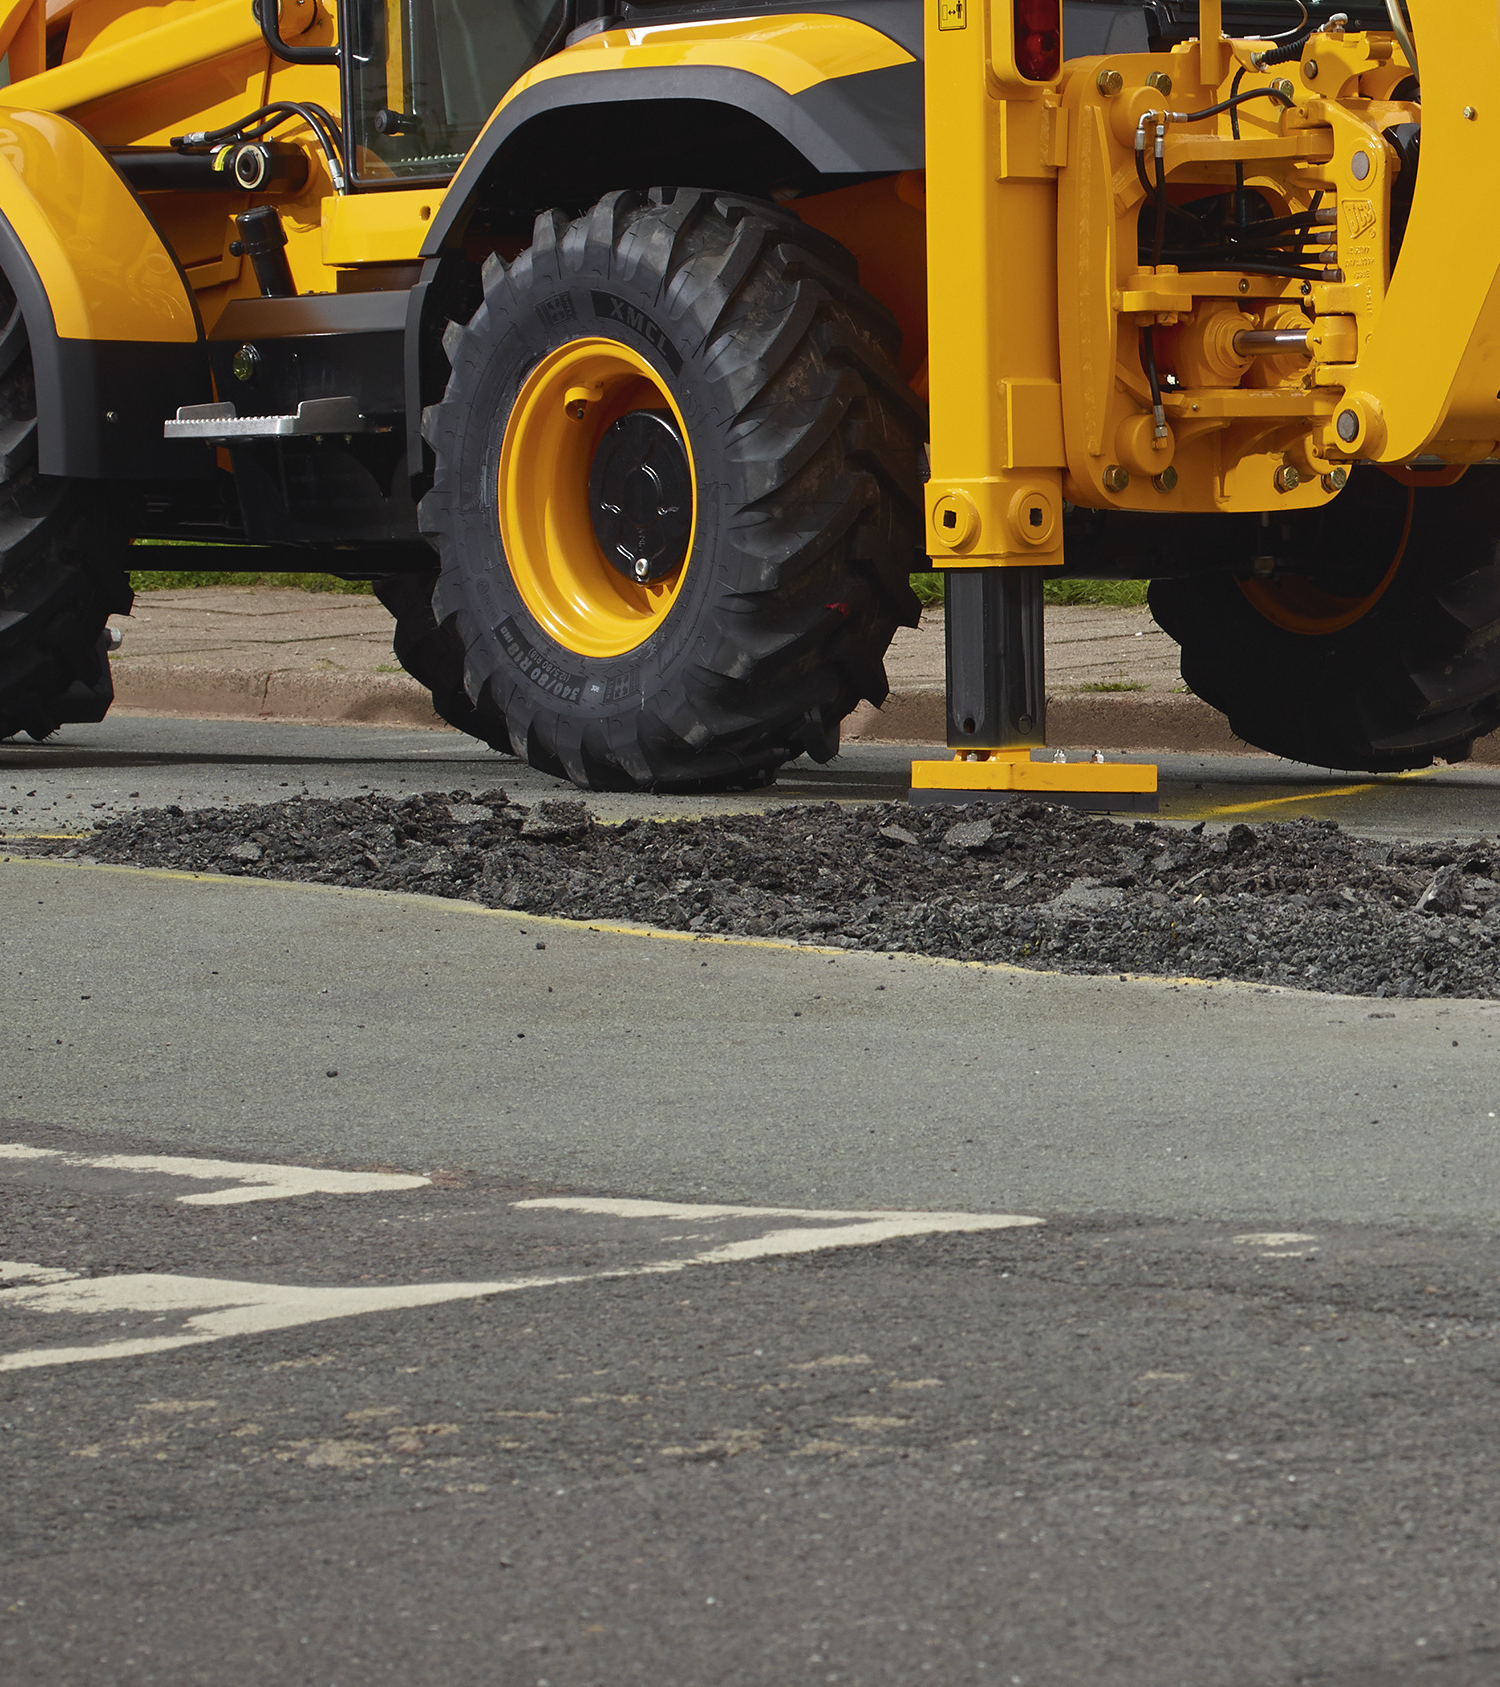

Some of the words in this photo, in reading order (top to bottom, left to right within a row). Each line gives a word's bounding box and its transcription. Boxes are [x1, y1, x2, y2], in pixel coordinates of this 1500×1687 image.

[610, 296, 667, 356] XMCL
[499, 625, 512, 643] IND
[507, 644, 533, 673] R18
[528, 648, 543, 665] R18)
[529, 669, 580, 700] 340/80
[541, 660, 571, 683] (12.5/80
